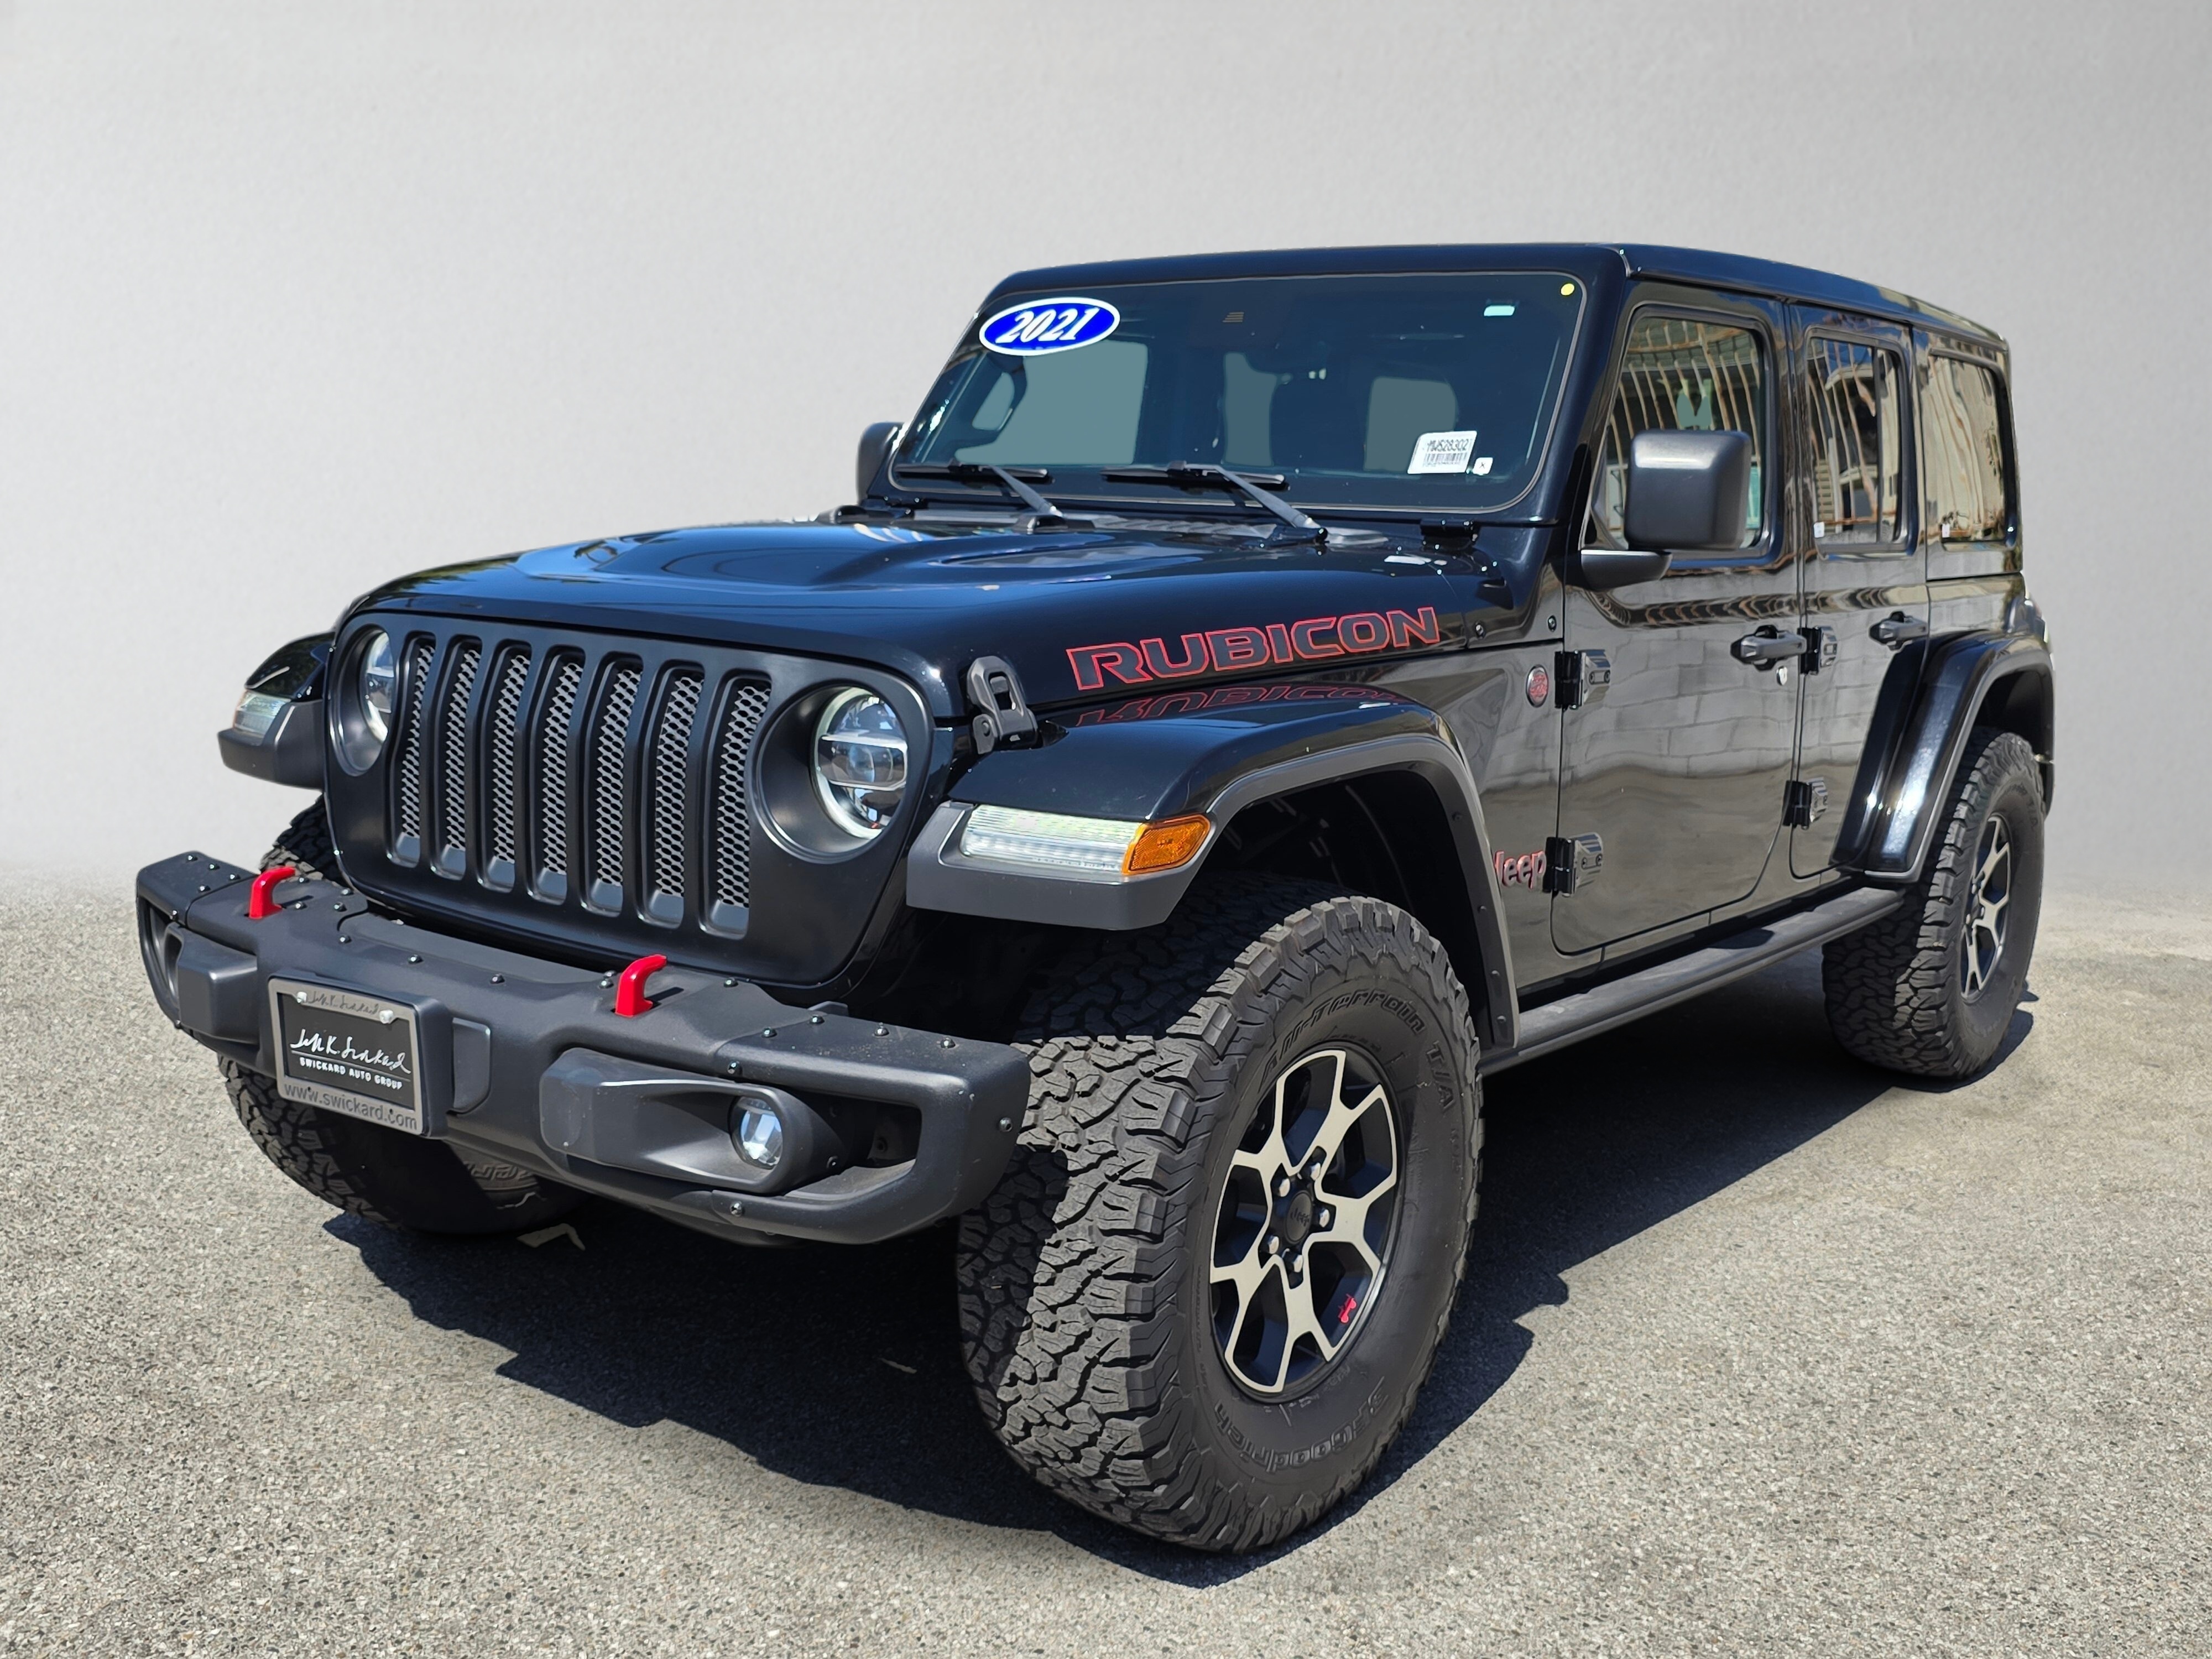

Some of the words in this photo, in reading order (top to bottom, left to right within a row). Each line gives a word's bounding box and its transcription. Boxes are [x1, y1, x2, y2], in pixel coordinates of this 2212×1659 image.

[995, 306, 1100, 342] 2021
[1066, 606, 1441, 691] RUBICON
[1494, 850, 1547, 890] Jeep
[299, 1057, 346, 1075] SWICKARD
[348, 1068, 372, 1082] AUTO
[374, 1074, 403, 1090] GROUP
[1426, 1040, 1457, 1112] T/A
[284, 1083, 418, 1130] www.swickard.com
